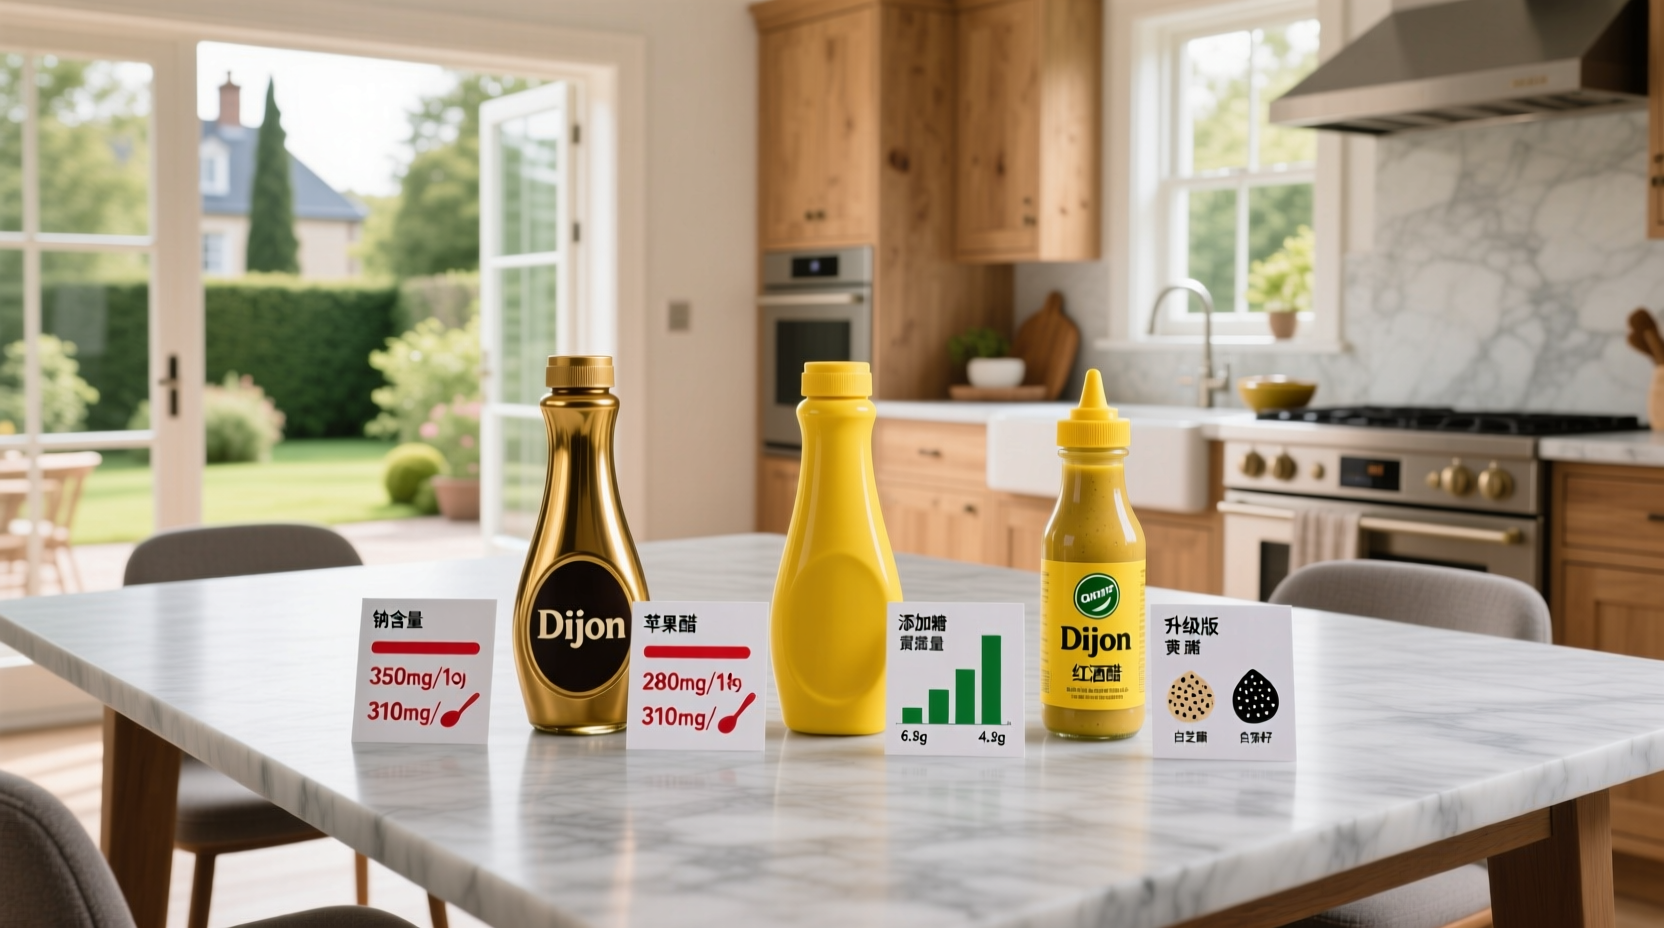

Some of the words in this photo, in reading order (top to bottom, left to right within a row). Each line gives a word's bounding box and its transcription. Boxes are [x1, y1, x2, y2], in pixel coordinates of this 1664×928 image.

[373, 610, 424, 629] 钠含量
[537, 609, 626, 649] Dijon
[643, 613, 698, 634] 苹果醋
[1164, 615, 1219, 636] 升级版
[1061, 625, 1131, 658] Dijon
